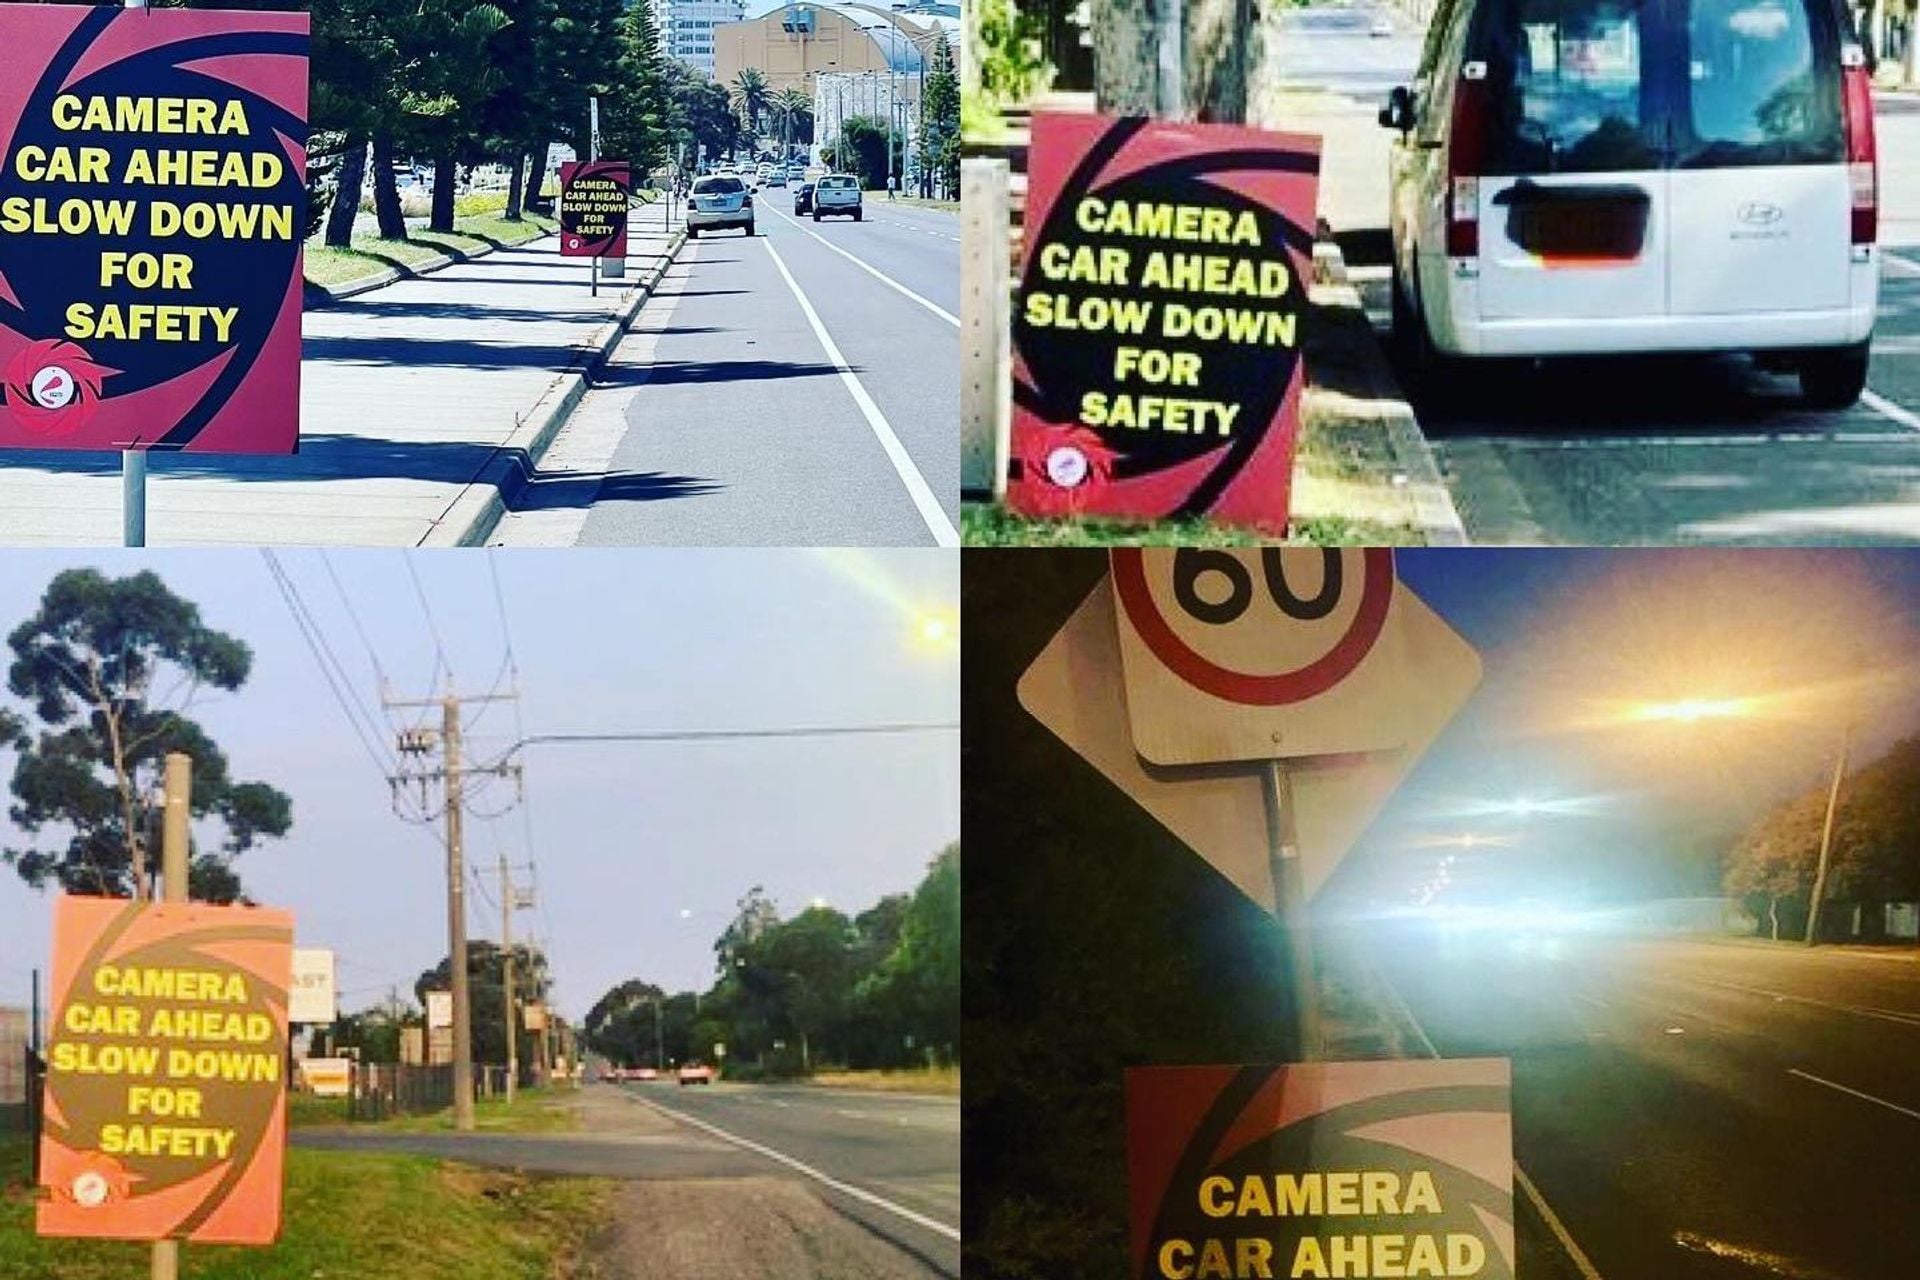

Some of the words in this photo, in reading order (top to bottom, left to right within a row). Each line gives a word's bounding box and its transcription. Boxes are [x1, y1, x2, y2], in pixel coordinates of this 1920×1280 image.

[52, 95, 249, 135] CAMERA
[16, 146, 110, 182] CAR
[124, 149, 282, 187] AHEAD
[573, 181, 617, 190] CAMERA
[562, 202, 592, 212] SLOW
[594, 203, 626, 213] DOWN
[565, 191, 587, 201] CAR
[589, 192, 624, 201] AHEAD
[0, 198, 136, 235] SLOW
[151, 202, 292, 239] DOWN
[576, 225, 615, 235] SAFETY
[583, 214, 605, 223] FOR
[1077, 198, 1260, 244] CAMERA
[101, 252, 193, 288] FOR
[1041, 243, 1129, 284] CAR
[1142, 252, 1288, 297] AHEAD
[64, 303, 238, 341] SAFETY
[1025, 293, 1152, 333] SLOW
[1163, 304, 1295, 346] DOWN
[1115, 347, 1202, 385] FOR
[1080, 392, 1240, 435] SAFETY
[95, 966, 246, 1003] CAMERA
[66, 1004, 140, 1036] CAR
[149, 1010, 271, 1041] AHEAD
[53, 1043, 159, 1074] SLOW
[169, 1050, 278, 1081] DOWN
[129, 1087, 201, 1117] FOR
[100, 1125, 234, 1157] SAFETY
[1199, 1170, 1443, 1218] CAMERA
[1160, 1238, 1273, 1280] CAR
[1292, 1234, 1485, 1277] AHEAD
